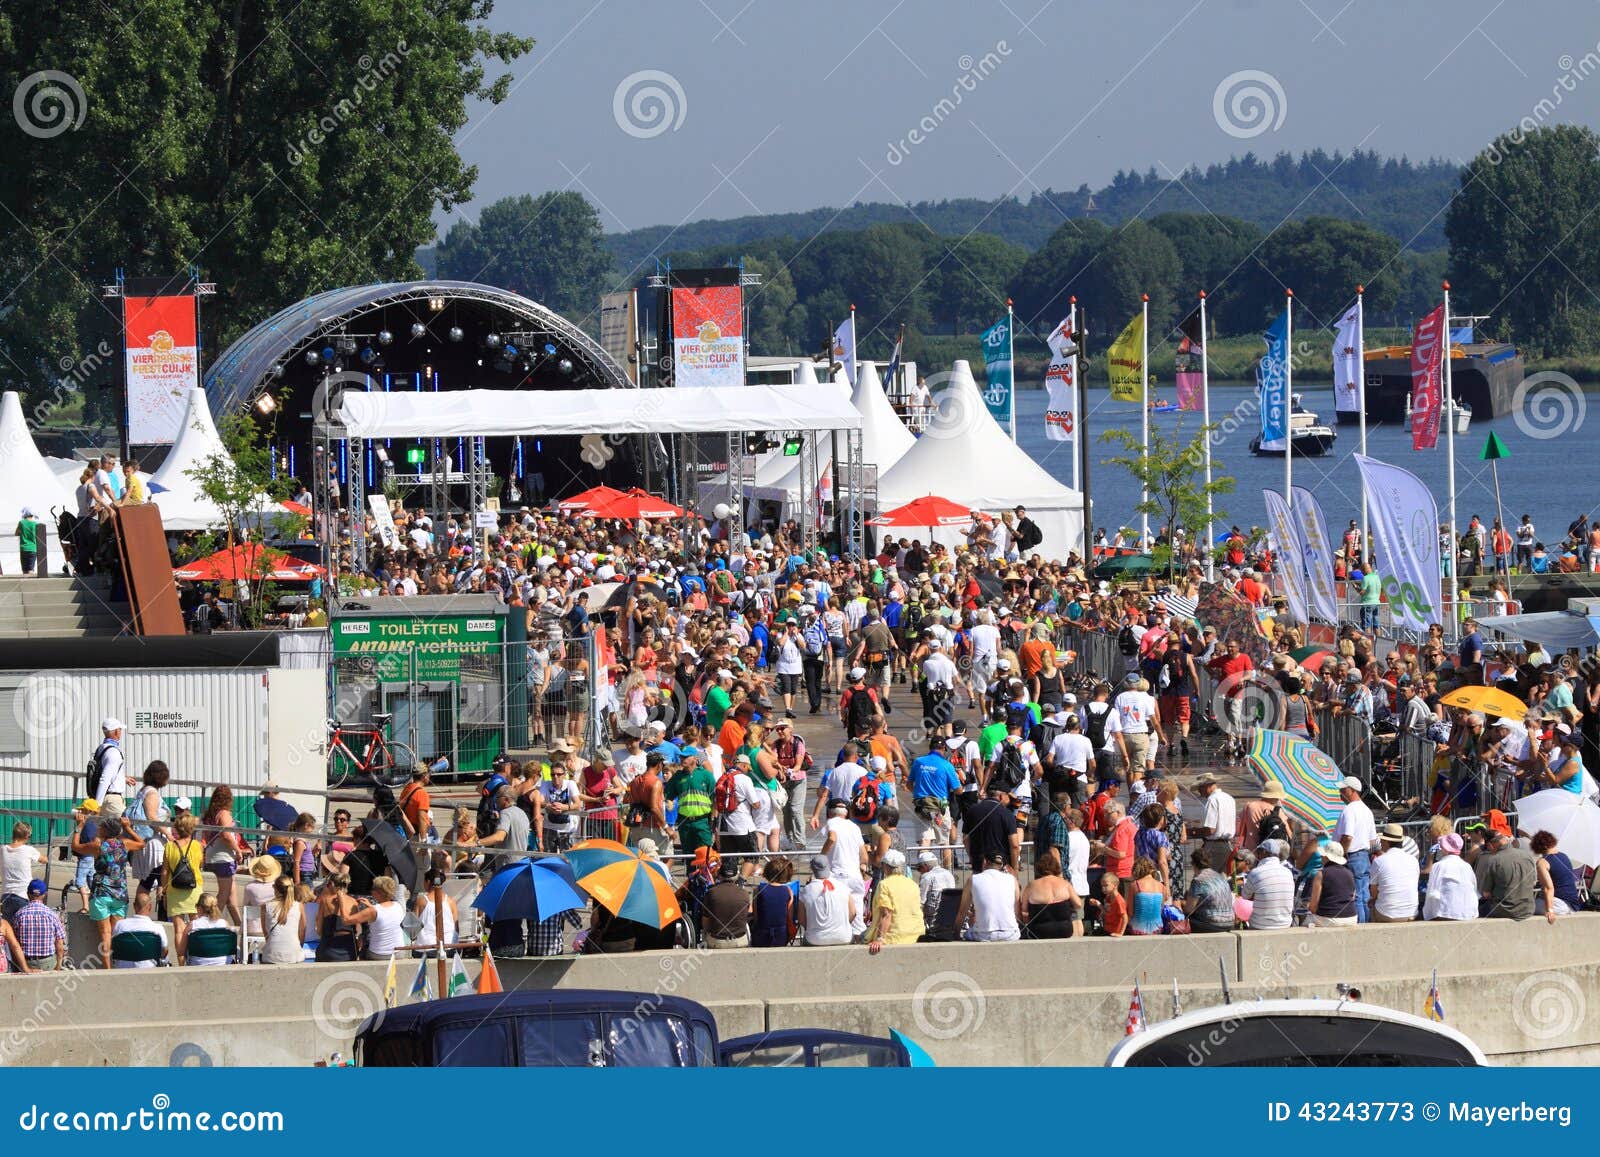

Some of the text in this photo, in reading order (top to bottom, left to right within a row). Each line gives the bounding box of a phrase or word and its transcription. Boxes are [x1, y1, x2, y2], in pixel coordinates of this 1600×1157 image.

[686, 461, 728, 472] Pimetim
[342, 624, 369, 633] HEREN
[379, 624, 459, 636] TOILETTEN
[468, 622, 495, 630] DAMES
[419, 639, 489, 653] verhuur
[152, 712, 183, 720] Roelofs
[152, 720, 199, 729] Bouwbedrijf
